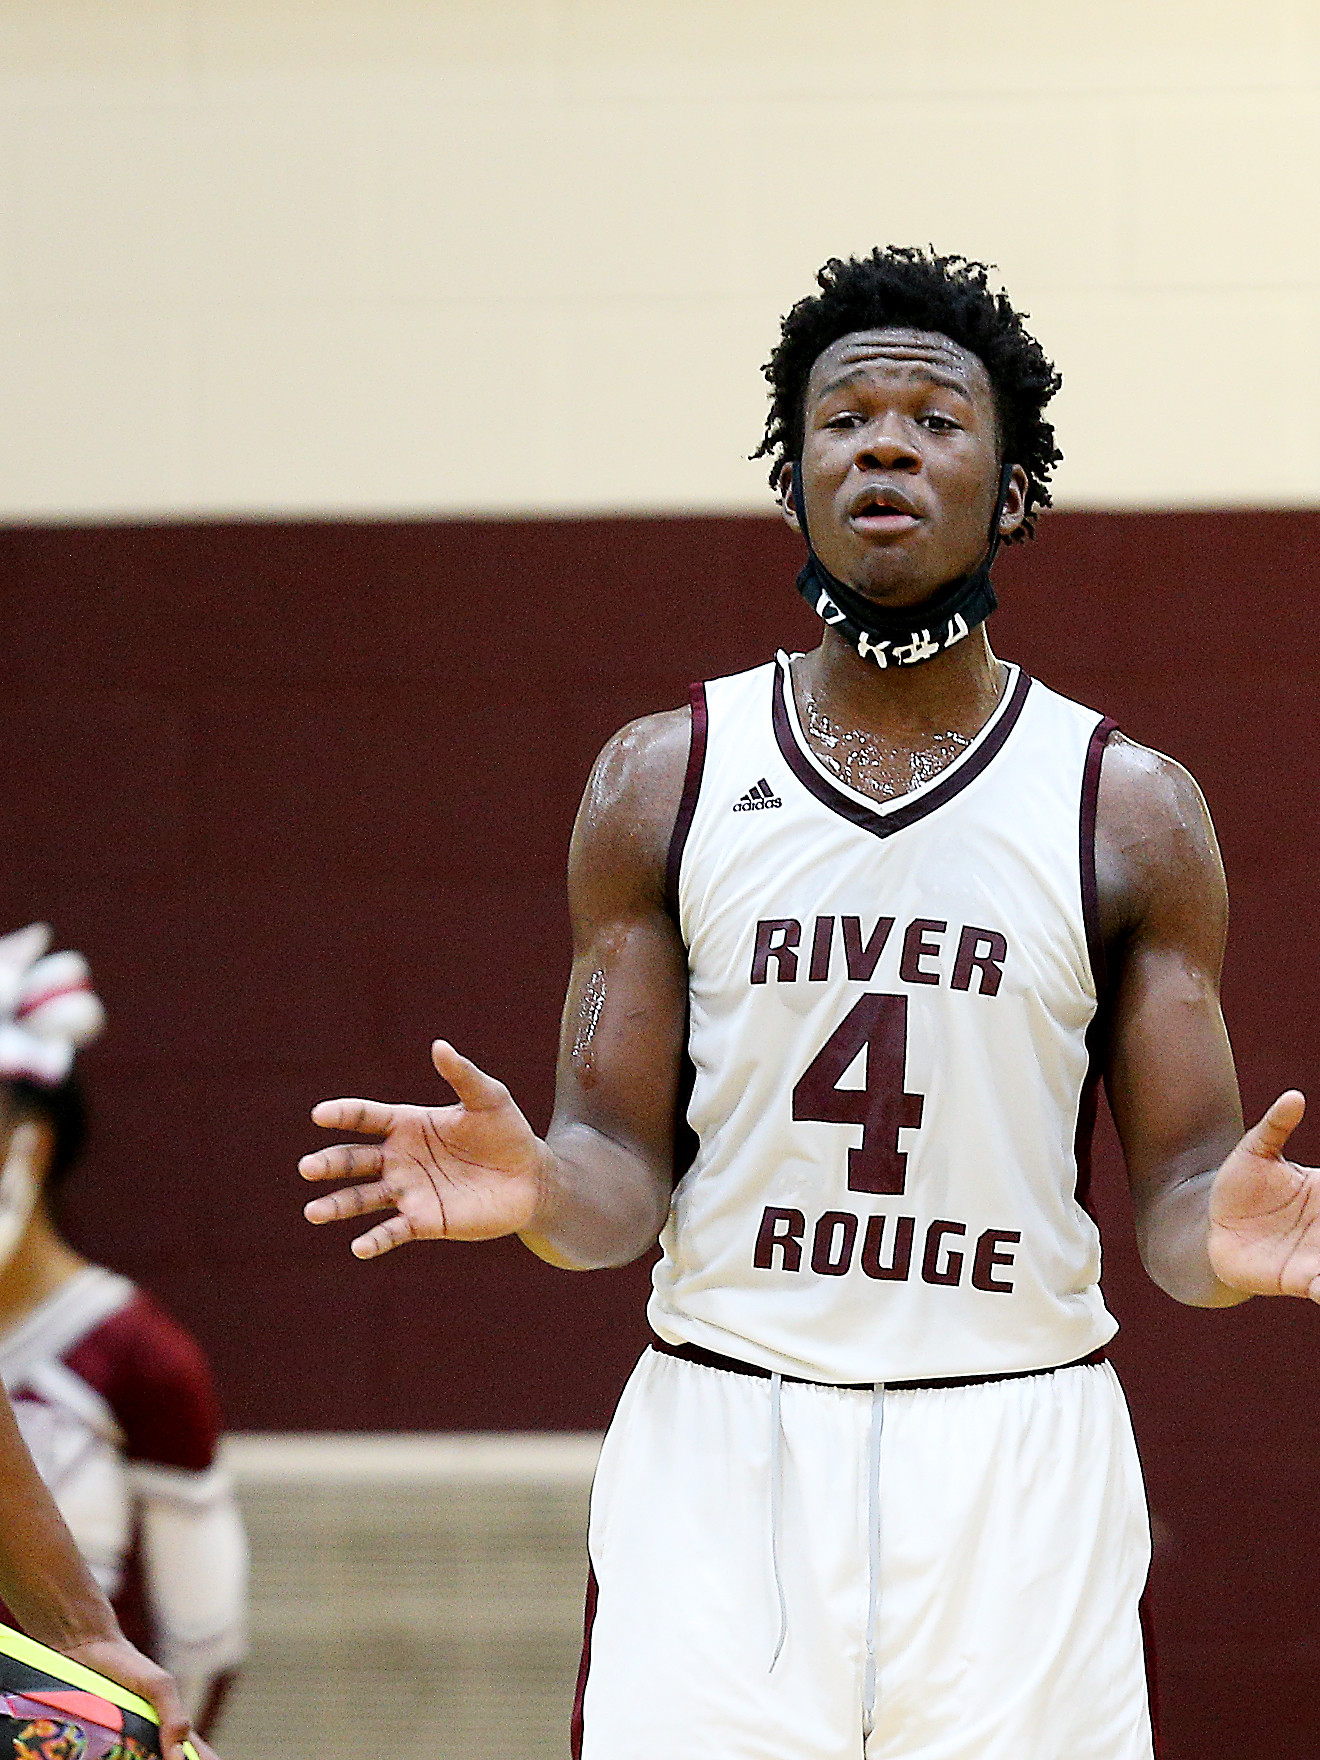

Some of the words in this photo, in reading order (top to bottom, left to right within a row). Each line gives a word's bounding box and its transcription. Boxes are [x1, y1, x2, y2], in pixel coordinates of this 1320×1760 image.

[732, 797, 783, 813] adidas
[750, 915, 1008, 997] RIVER
[792, 992, 925, 1195] 4
[753, 1206, 1022, 1294] ROUGE
